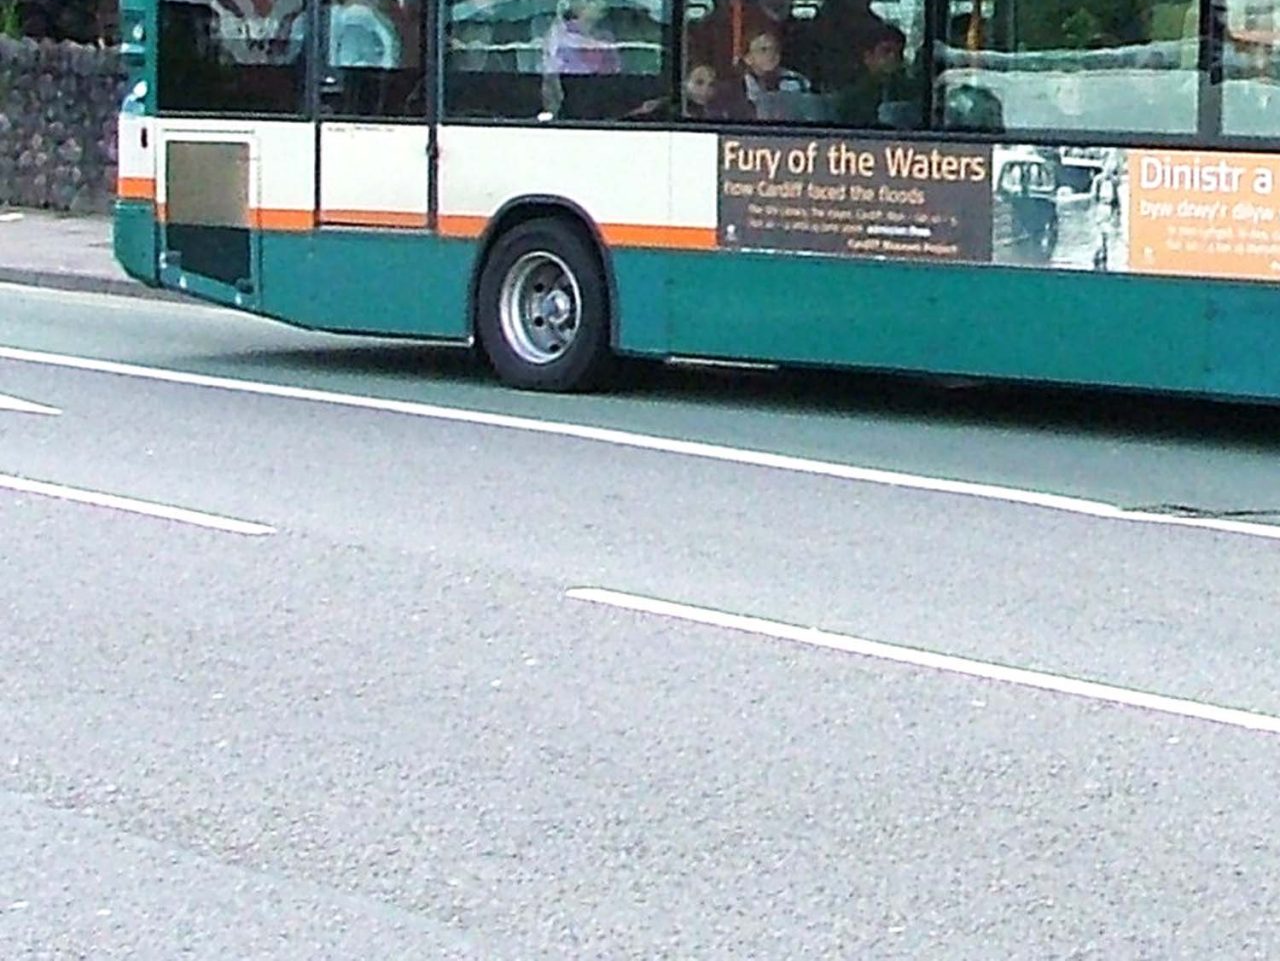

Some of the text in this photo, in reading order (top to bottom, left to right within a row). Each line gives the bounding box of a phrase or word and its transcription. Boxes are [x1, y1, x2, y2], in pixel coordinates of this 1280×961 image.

[723, 141, 987, 182] Fury of the Waters
[1139, 156, 1246, 194] Dinistr
[1252, 166, 1273, 195] a
[757, 181, 803, 199] Cardiff
[807, 182, 846, 201] faced
[849, 185, 875, 203] the
[879, 185, 926, 205] floods
[1139, 198, 1173, 221] byw
